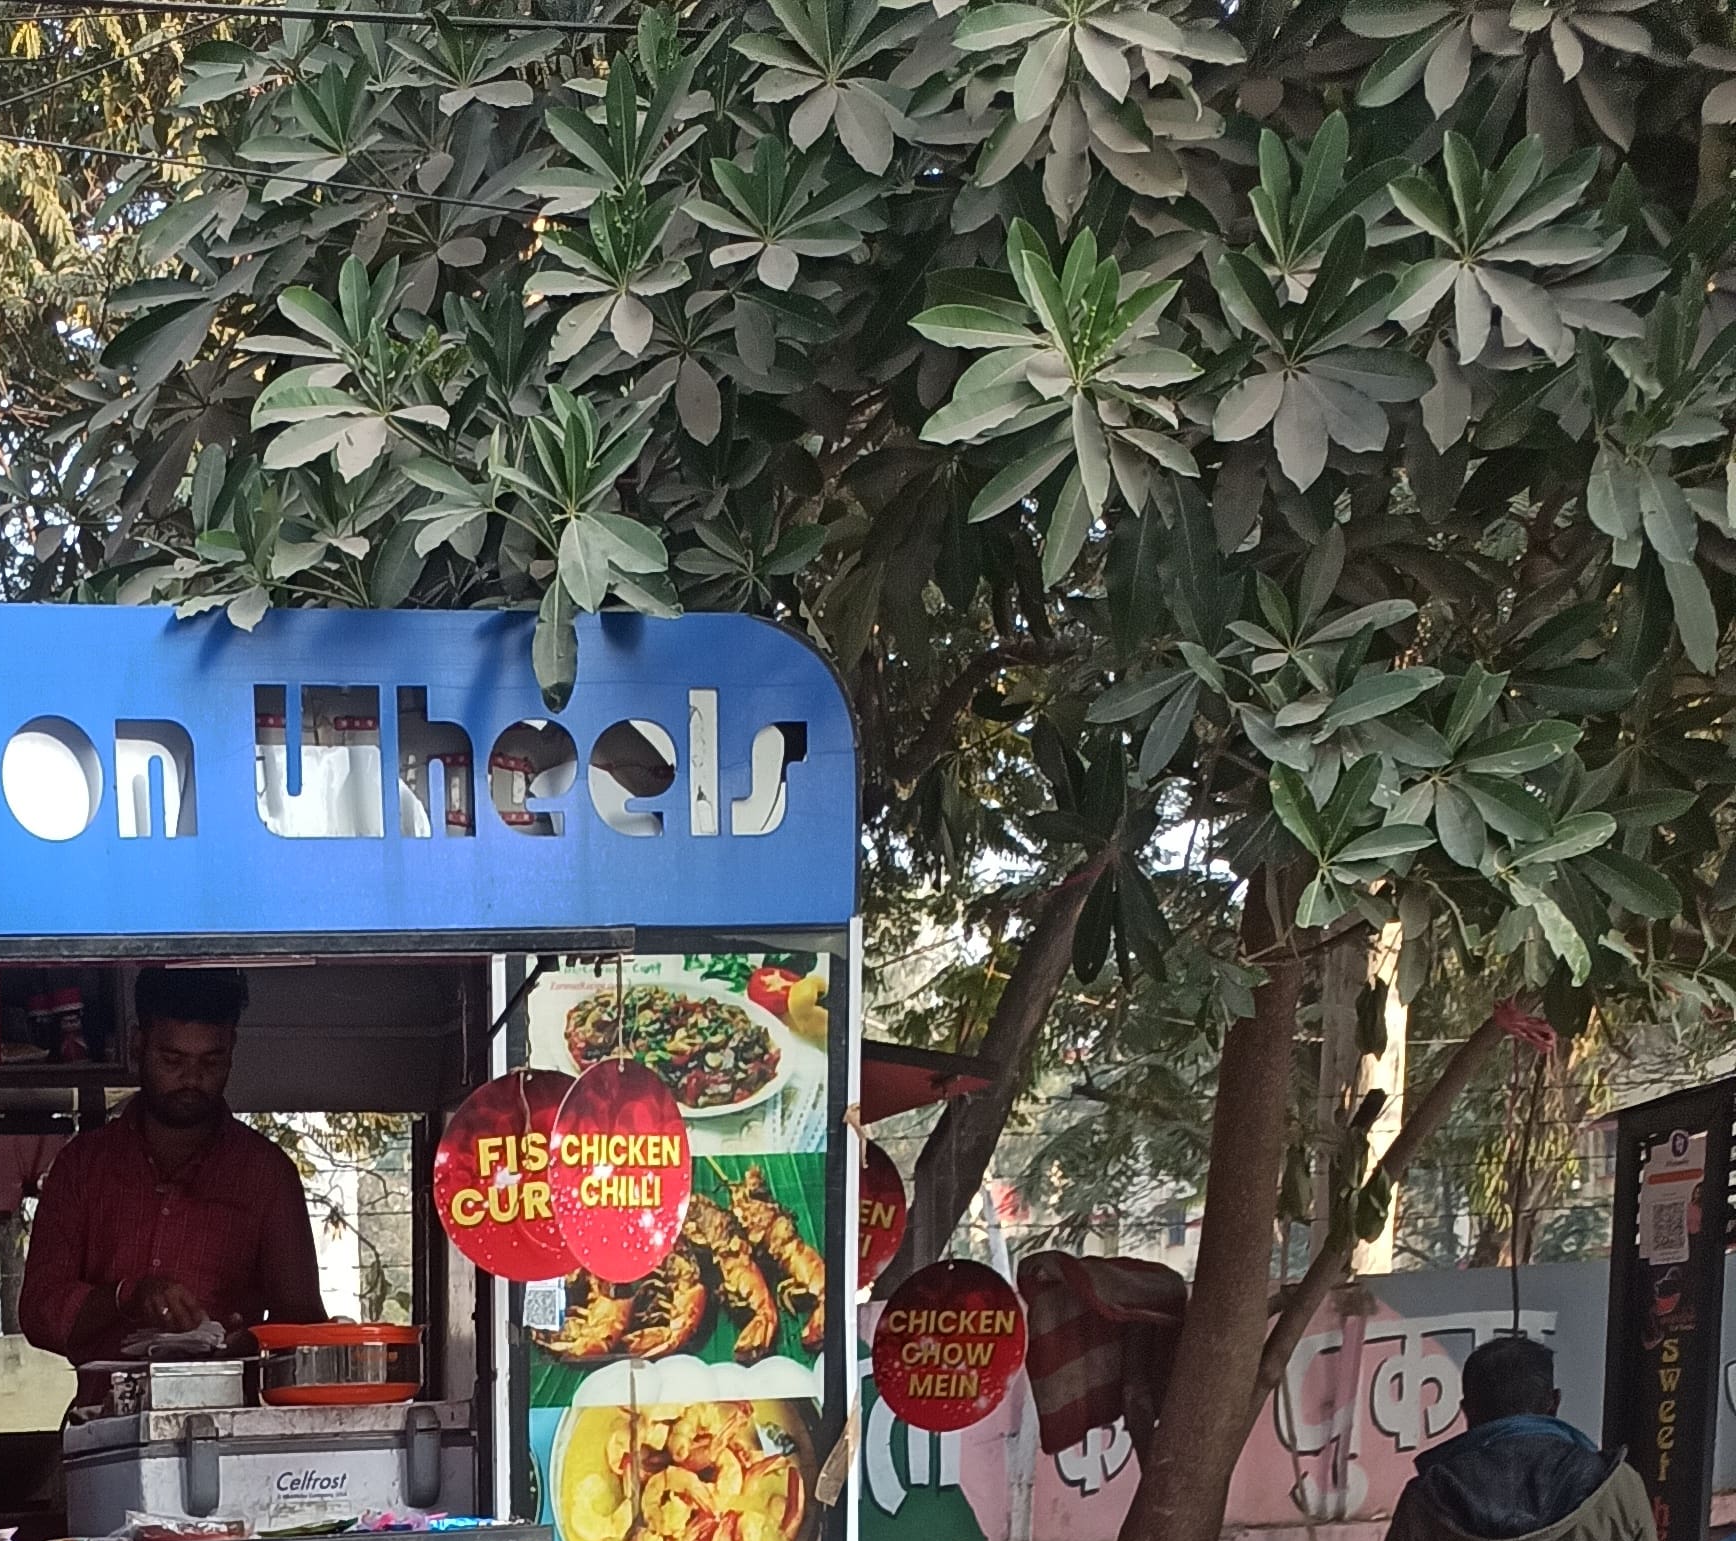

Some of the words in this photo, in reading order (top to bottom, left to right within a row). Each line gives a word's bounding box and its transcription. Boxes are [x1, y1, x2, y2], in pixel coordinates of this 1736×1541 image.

[1, 714, 197, 839] on
[252, 683, 810, 839] Wheels
[477, 1131, 550, 1178] FIS
[560, 1133, 682, 1168] CHICKEN
[451, 1186, 554, 1227] CUR
[580, 1175, 662, 1208] CHILLI
[888, 1309, 1016, 1336] CHICKEN
[901, 1341, 995, 1368] CHOW
[907, 1372, 980, 1399] MEIN
[276, 1469, 347, 1492] Celfrost
